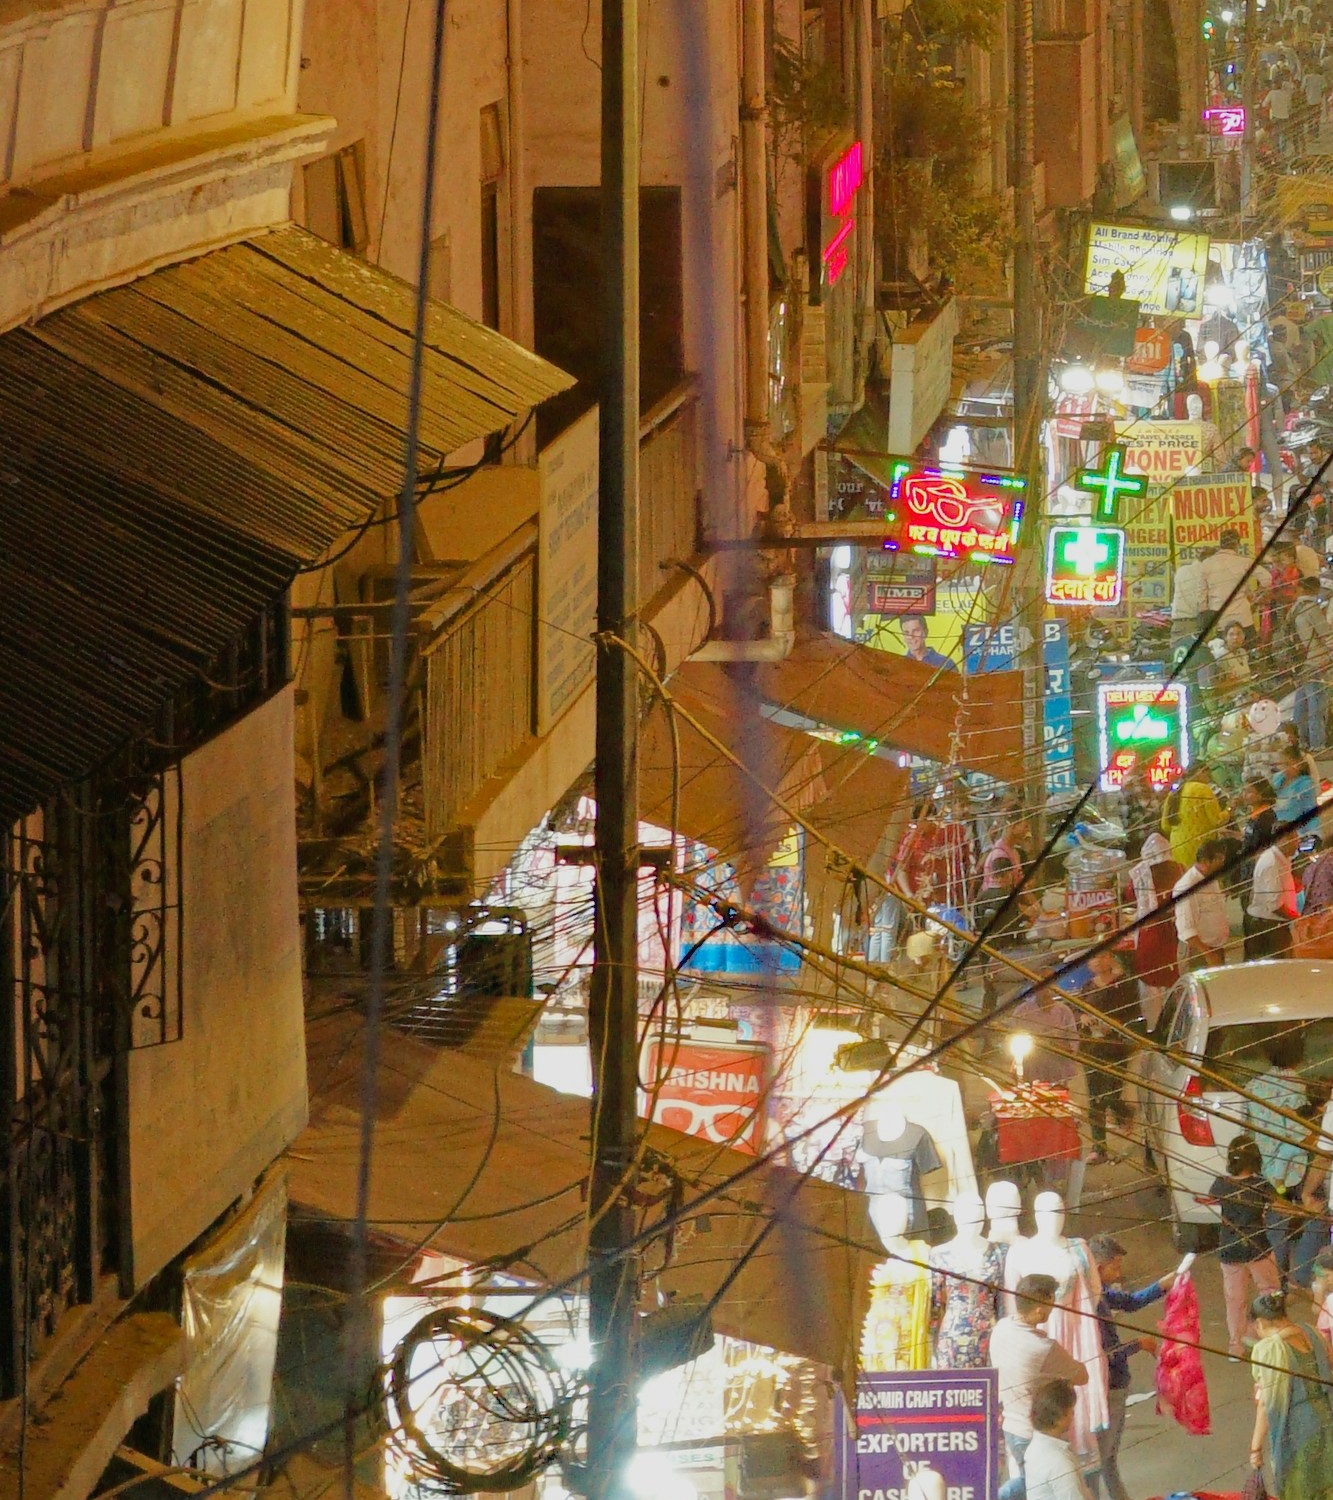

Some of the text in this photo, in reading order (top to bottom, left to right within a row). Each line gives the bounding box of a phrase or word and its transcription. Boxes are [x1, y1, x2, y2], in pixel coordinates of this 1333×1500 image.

[1095, 227, 1108, 238] All
[1111, 230, 1139, 241] Brand
[1158, 440, 1199, 449] PRICE
[1118, 498, 1169, 525] ONEY
[1174, 486, 1248, 521] MONEY
[1125, 528, 1168, 545] NGER
[1124, 547, 1168, 557] MISSION
[856, 1388, 983, 1410] ASHMIR CRAFT STORE
[856, 1430, 978, 1455] EXPORTERS
[903, 1460, 931, 1481] OF
